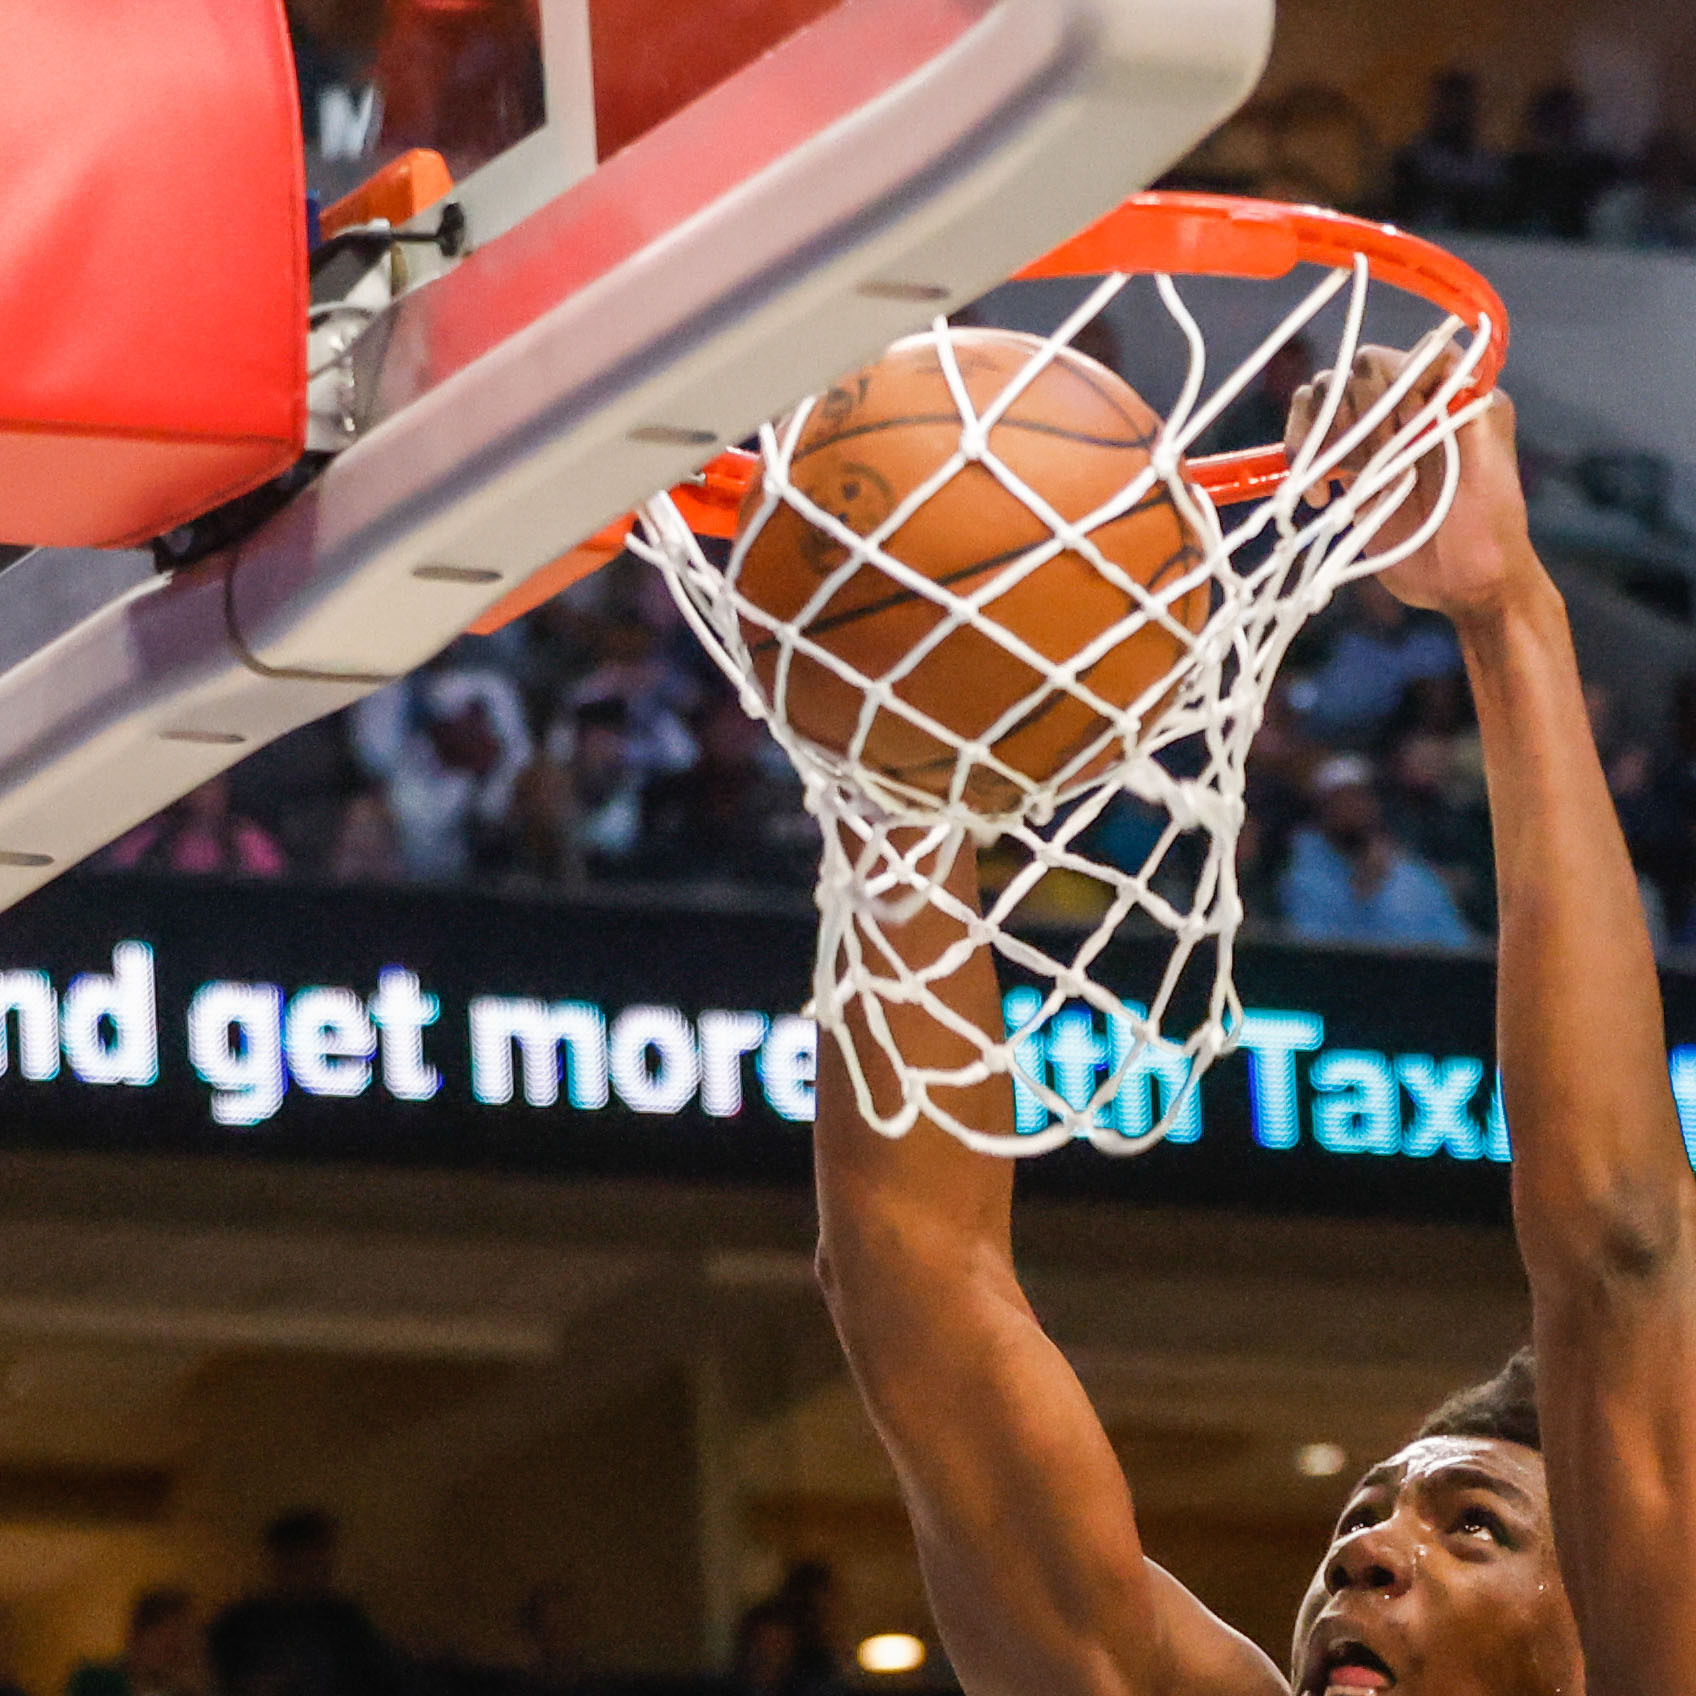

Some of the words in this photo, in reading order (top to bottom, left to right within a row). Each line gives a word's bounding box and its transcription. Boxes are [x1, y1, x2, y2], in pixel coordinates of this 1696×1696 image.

[188, 966, 443, 1126] get
[468, 997, 817, 1121] more
[1004, 986, 1202, 1143] ith
